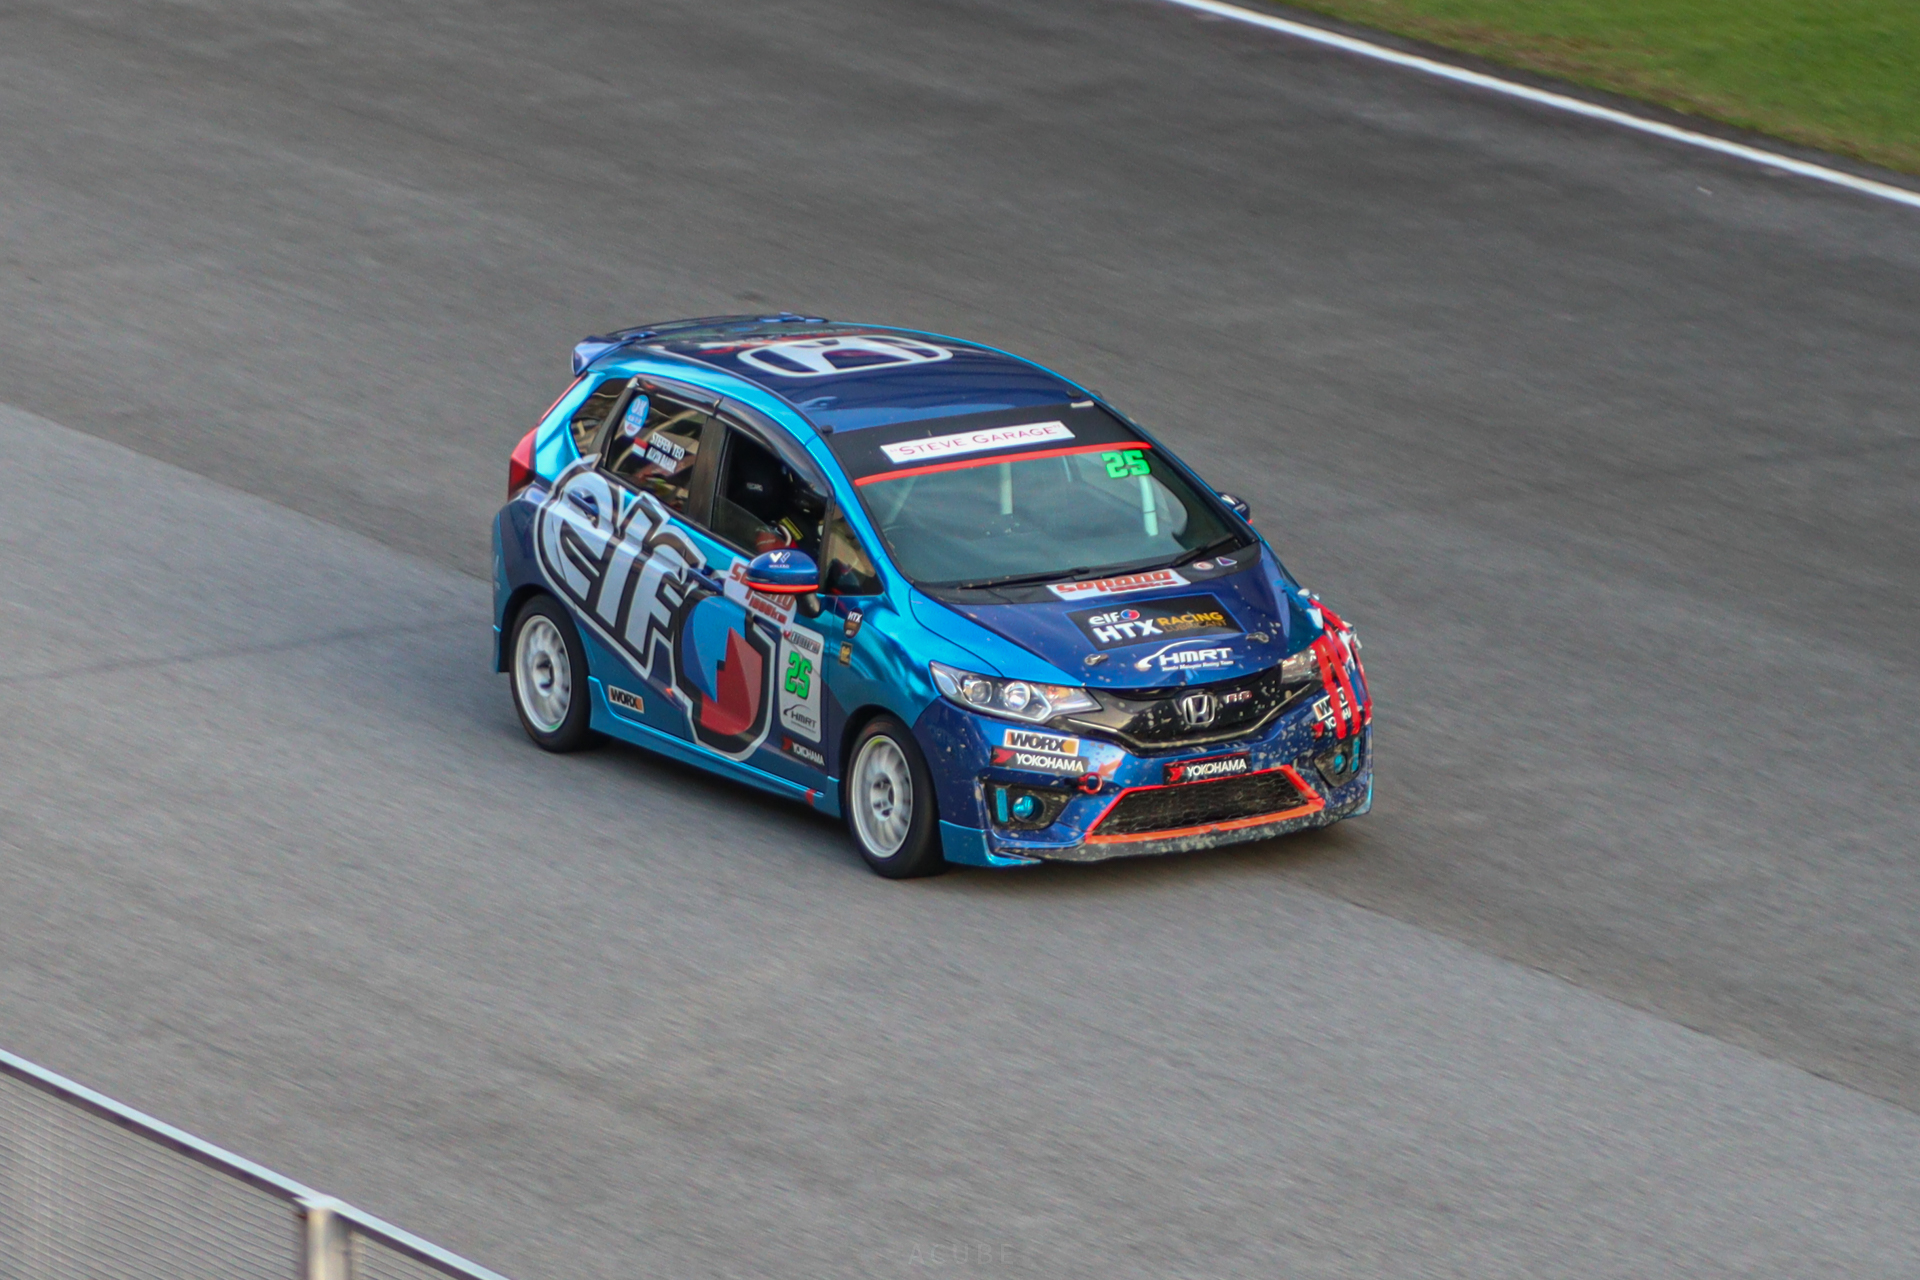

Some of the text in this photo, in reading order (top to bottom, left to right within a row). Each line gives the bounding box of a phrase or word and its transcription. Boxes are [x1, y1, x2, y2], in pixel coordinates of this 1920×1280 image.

[1101, 449, 1151, 479] 25
[847, 611, 863, 623] HTX
[1088, 611, 1121, 626] elf
[1157, 611, 1225, 627] RACING
[1163, 619, 1228, 633] LUBRICANT
[1093, 618, 1164, 644] HTX
[1159, 647, 1233, 666] HMRT
[784, 650, 813, 700] 25
[611, 688, 638, 709] WORX
[791, 710, 818, 729] HMRT
[1011, 732, 1066, 754] WORX
[1016, 752, 1085, 773] YOKOHAMA
[1186, 758, 1248, 777] YOKOHAMA
